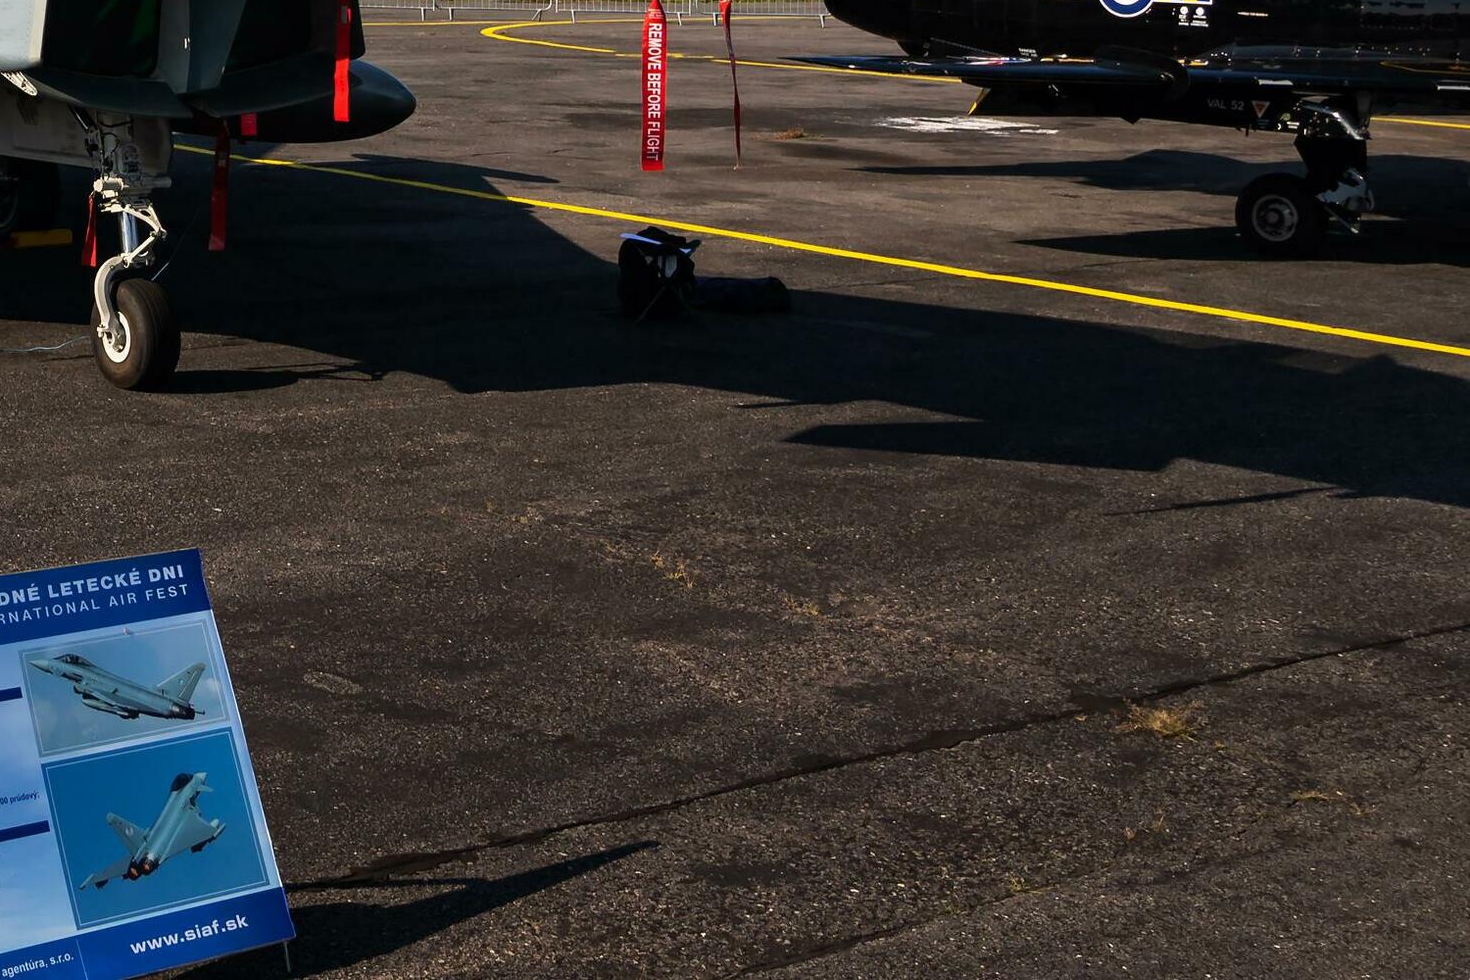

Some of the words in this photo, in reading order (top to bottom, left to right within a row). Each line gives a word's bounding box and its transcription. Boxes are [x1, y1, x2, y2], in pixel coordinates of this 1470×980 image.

[647, 22, 662, 70] REMOVE
[647, 73, 661, 119] BEFORE
[646, 121, 661, 161] FLIGHT
[48, 566, 142, 598] LETECKÉ
[148, 564, 184, 583] DNI
[109, 592, 137, 607] AIR
[145, 584, 188, 602] FEST
[130, 915, 248, 954] www.siaf.sk
[2, 959, 48, 977] agentúra,
[50, 953, 74, 965] s.r.o.
